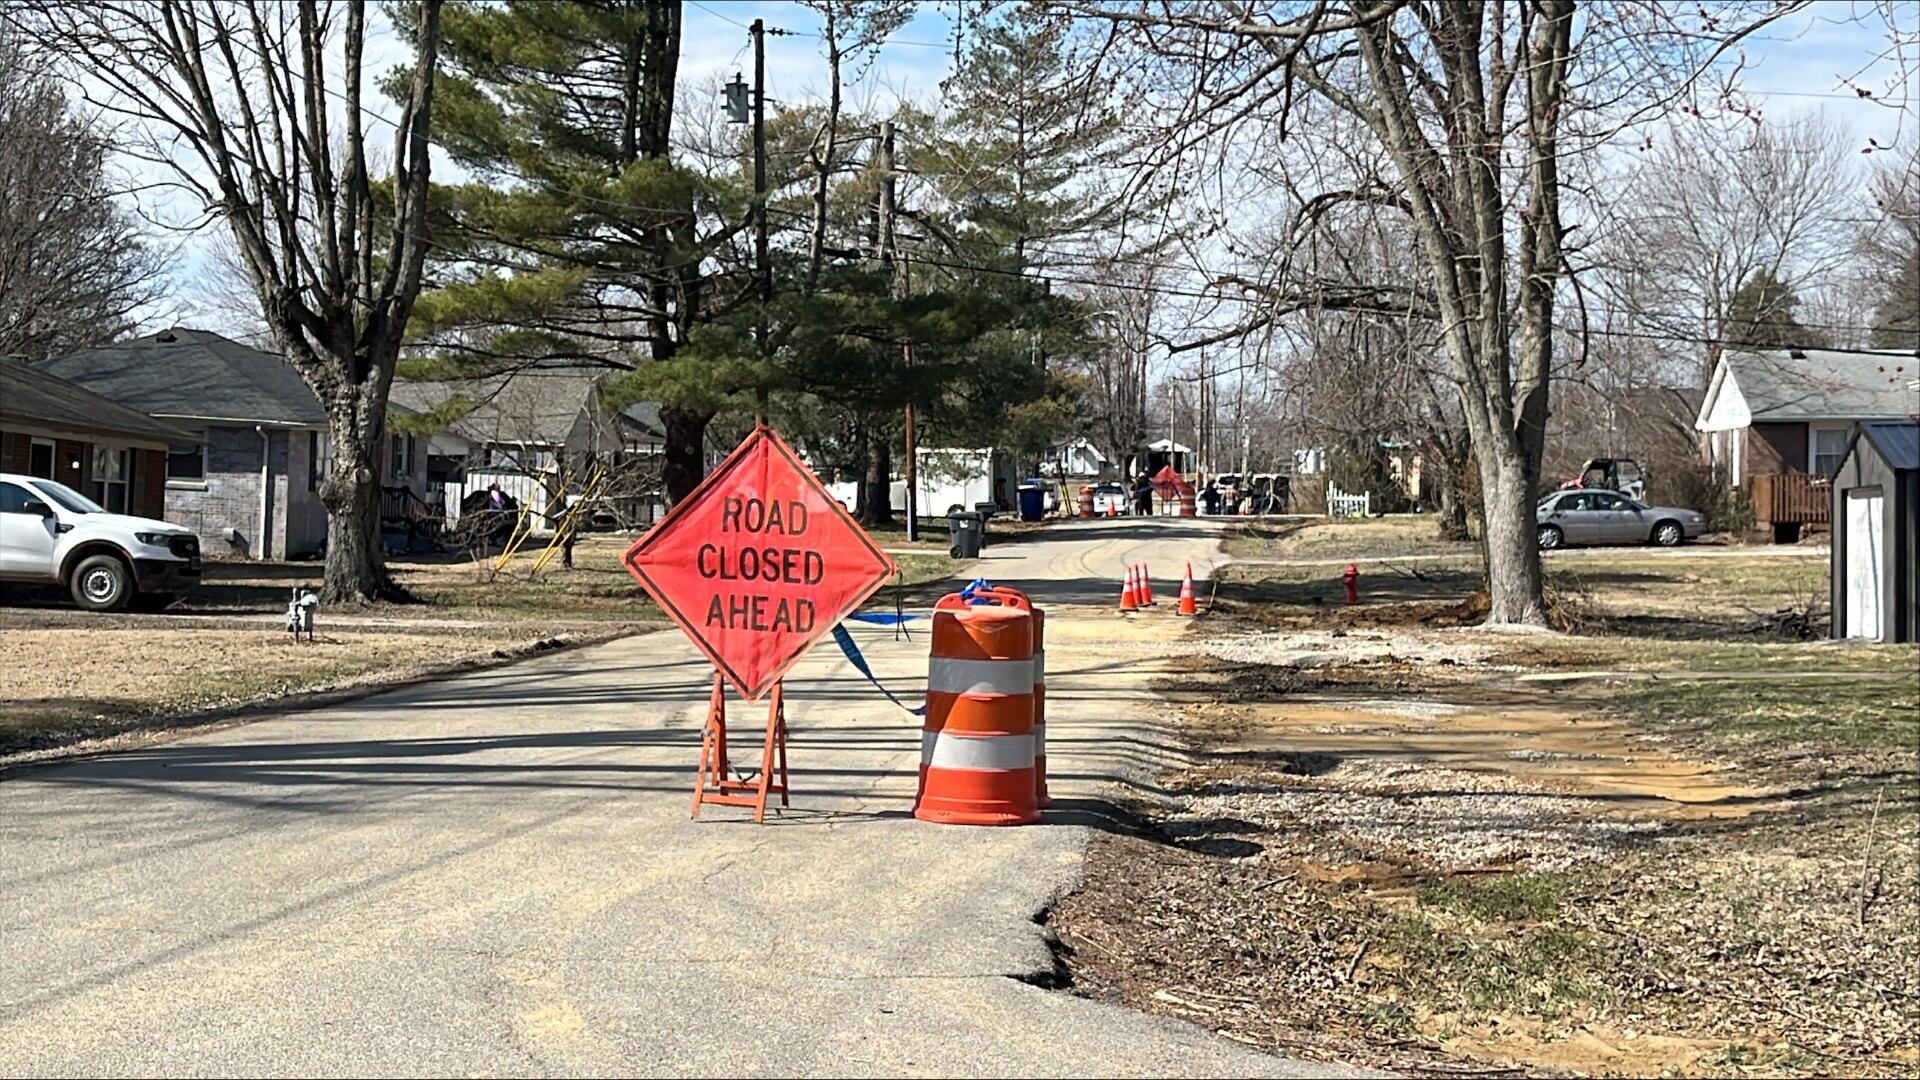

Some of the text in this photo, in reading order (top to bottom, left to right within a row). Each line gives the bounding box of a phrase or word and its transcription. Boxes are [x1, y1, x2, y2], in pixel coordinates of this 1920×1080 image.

[722, 496, 808, 536] ROAD
[697, 543, 824, 585] CLOSED
[705, 594, 816, 633] AHEAD
